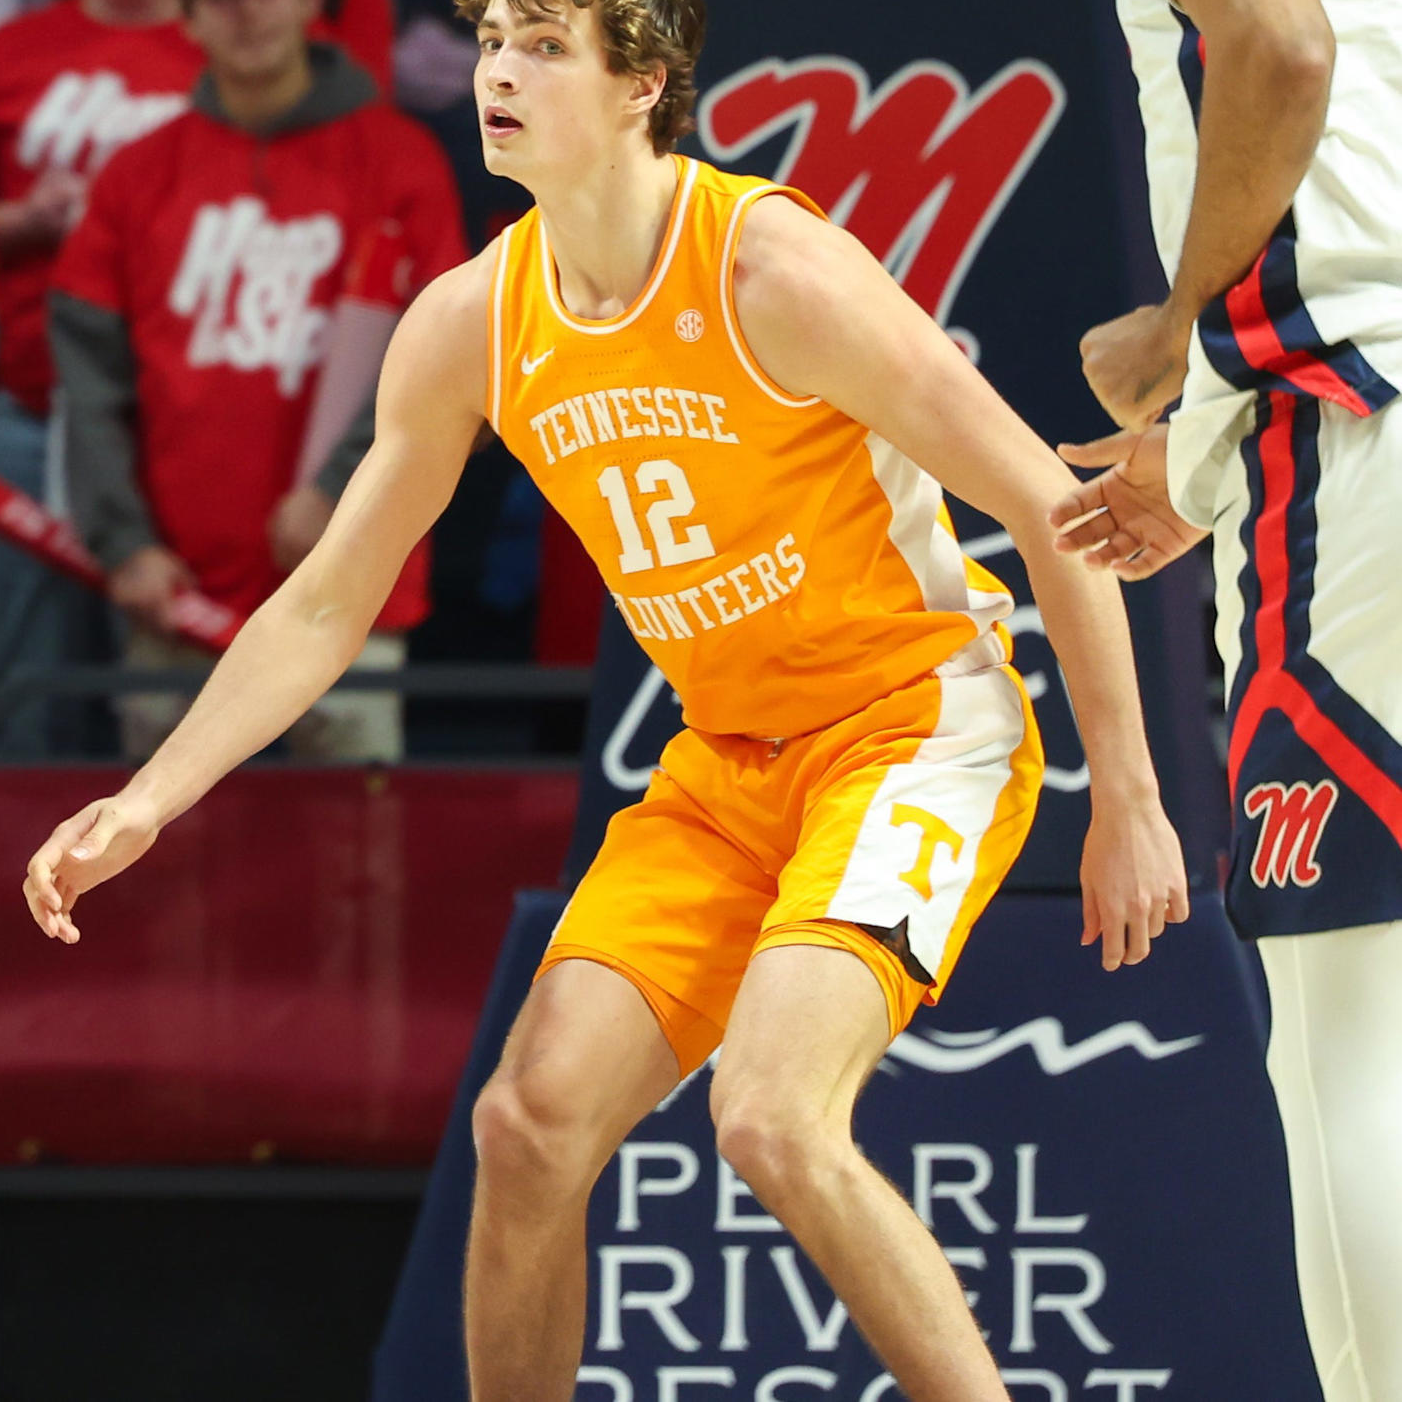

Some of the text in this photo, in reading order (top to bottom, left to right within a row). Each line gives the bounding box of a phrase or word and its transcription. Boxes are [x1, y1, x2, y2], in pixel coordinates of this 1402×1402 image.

[676, 309, 704, 342] SEC
[529, 387, 741, 465] TENNESSEE
[596, 459, 716, 574] 12
[610, 533, 806, 641] LUNTEERS
[889, 802, 964, 903] T
[1244, 779, 1339, 888] M
[616, 1142, 1089, 1234] PERL
[596, 1245, 1115, 1354] RIVR
